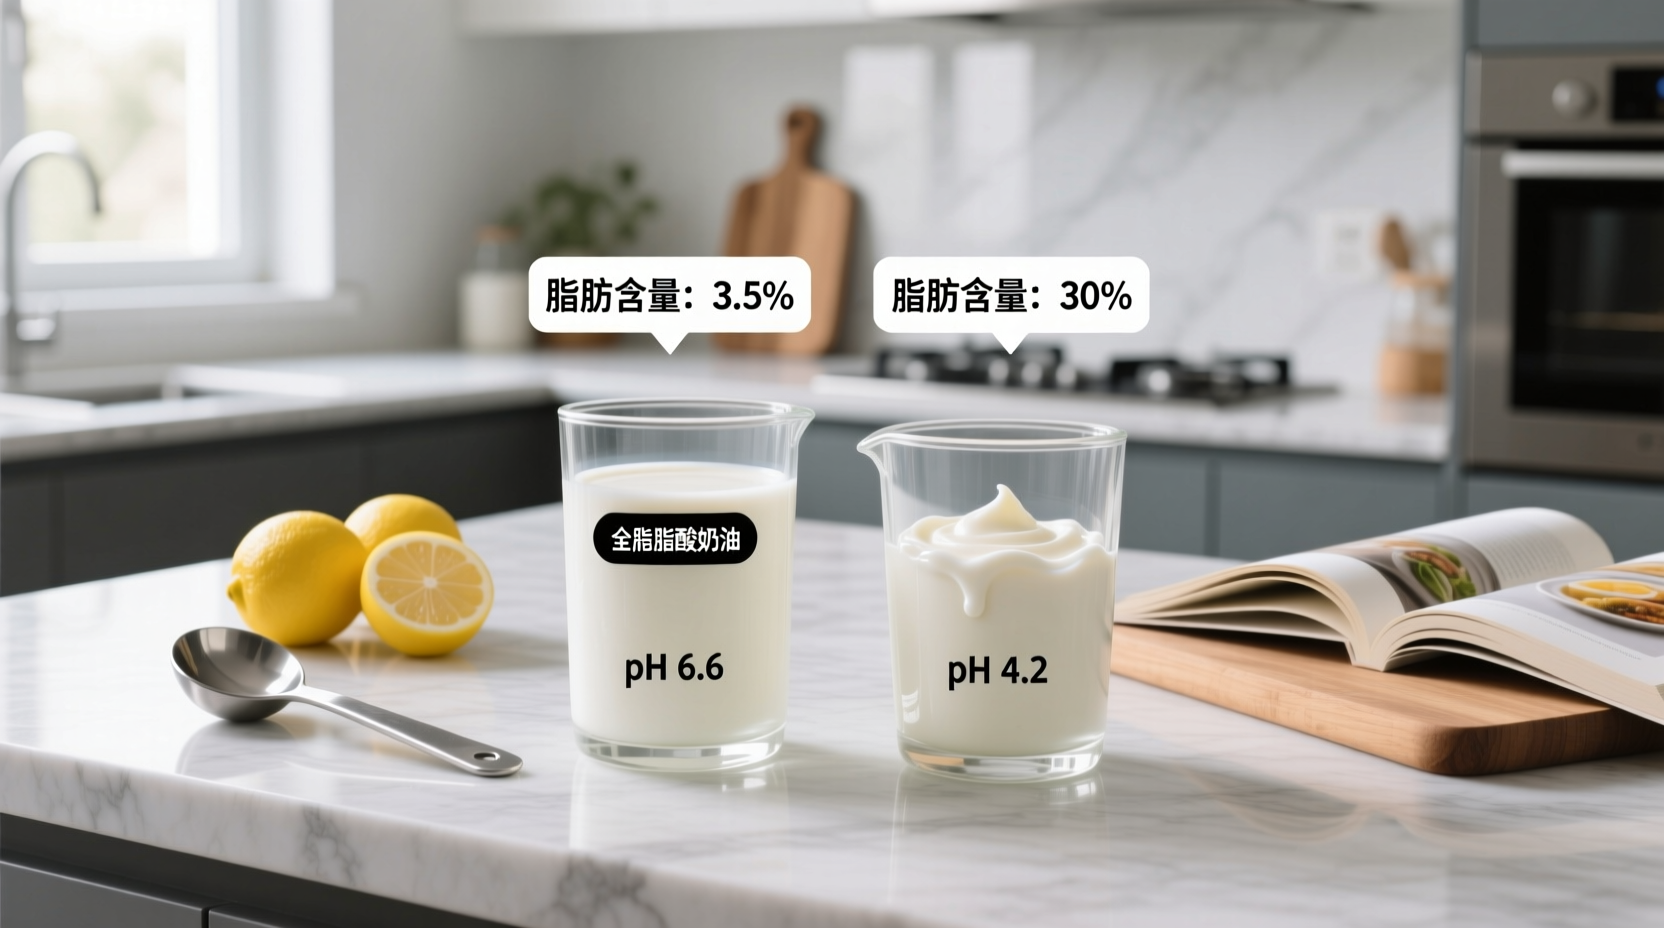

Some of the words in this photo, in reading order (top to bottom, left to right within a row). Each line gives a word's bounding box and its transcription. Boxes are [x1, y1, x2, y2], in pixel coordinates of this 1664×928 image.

[626, 653, 666, 688] pH
[678, 652, 723, 681] 6.6
[949, 656, 990, 691] pH
[1001, 655, 1048, 684] 4.2
